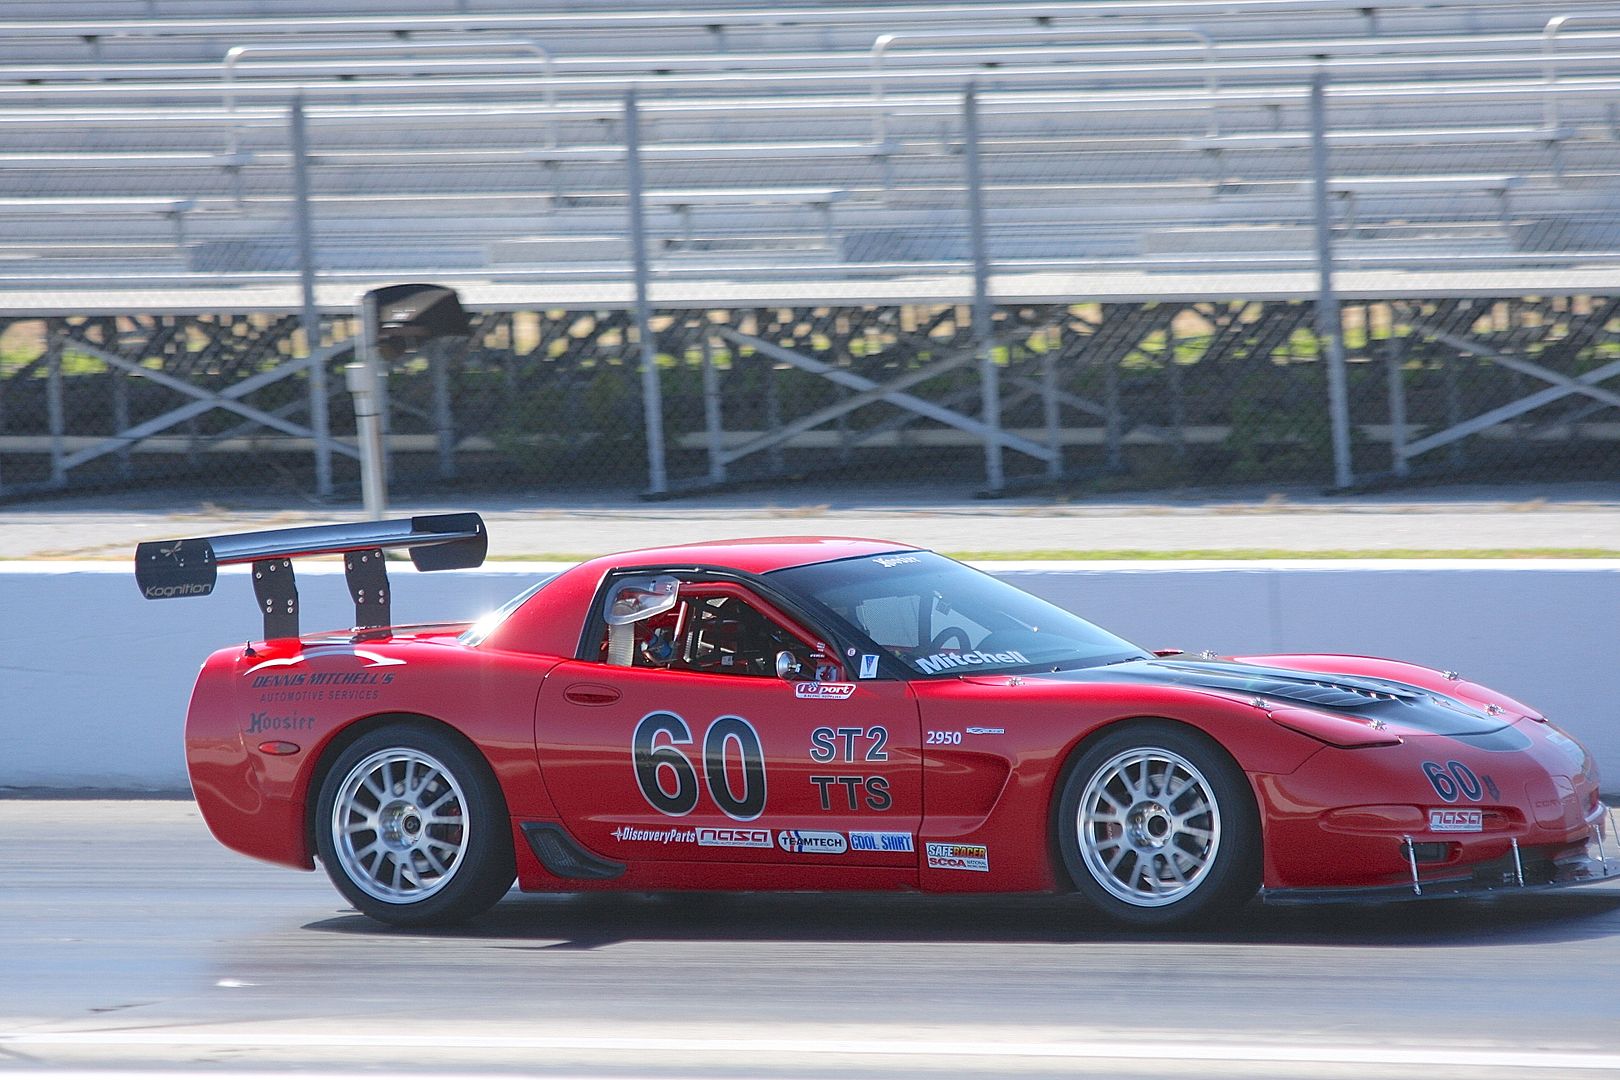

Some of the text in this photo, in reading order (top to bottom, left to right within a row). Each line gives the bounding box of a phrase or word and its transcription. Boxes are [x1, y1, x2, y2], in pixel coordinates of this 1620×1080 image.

[145, 584, 212, 596] Kognition
[915, 651, 1031, 674] Mitchell
[252, 672, 395, 688] DENNIS MITCHELL'S
[260, 689, 379, 702] AUTOMOTIVE SERVICES
[246, 711, 316, 734] Hoosier
[809, 726, 889, 763] ST2
[926, 731, 962, 744] 2950
[632, 710, 767, 821] 60
[1420, 760, 1484, 803] 60
[809, 775, 893, 811] TTS
[622, 827, 696, 844] DiscoveryParts
[700, 829, 768, 842] nasa
[782, 837, 842, 847] TEAMTECH
[851, 834, 911, 851] COOL SHIRT
[929, 858, 966, 867] SCCA
